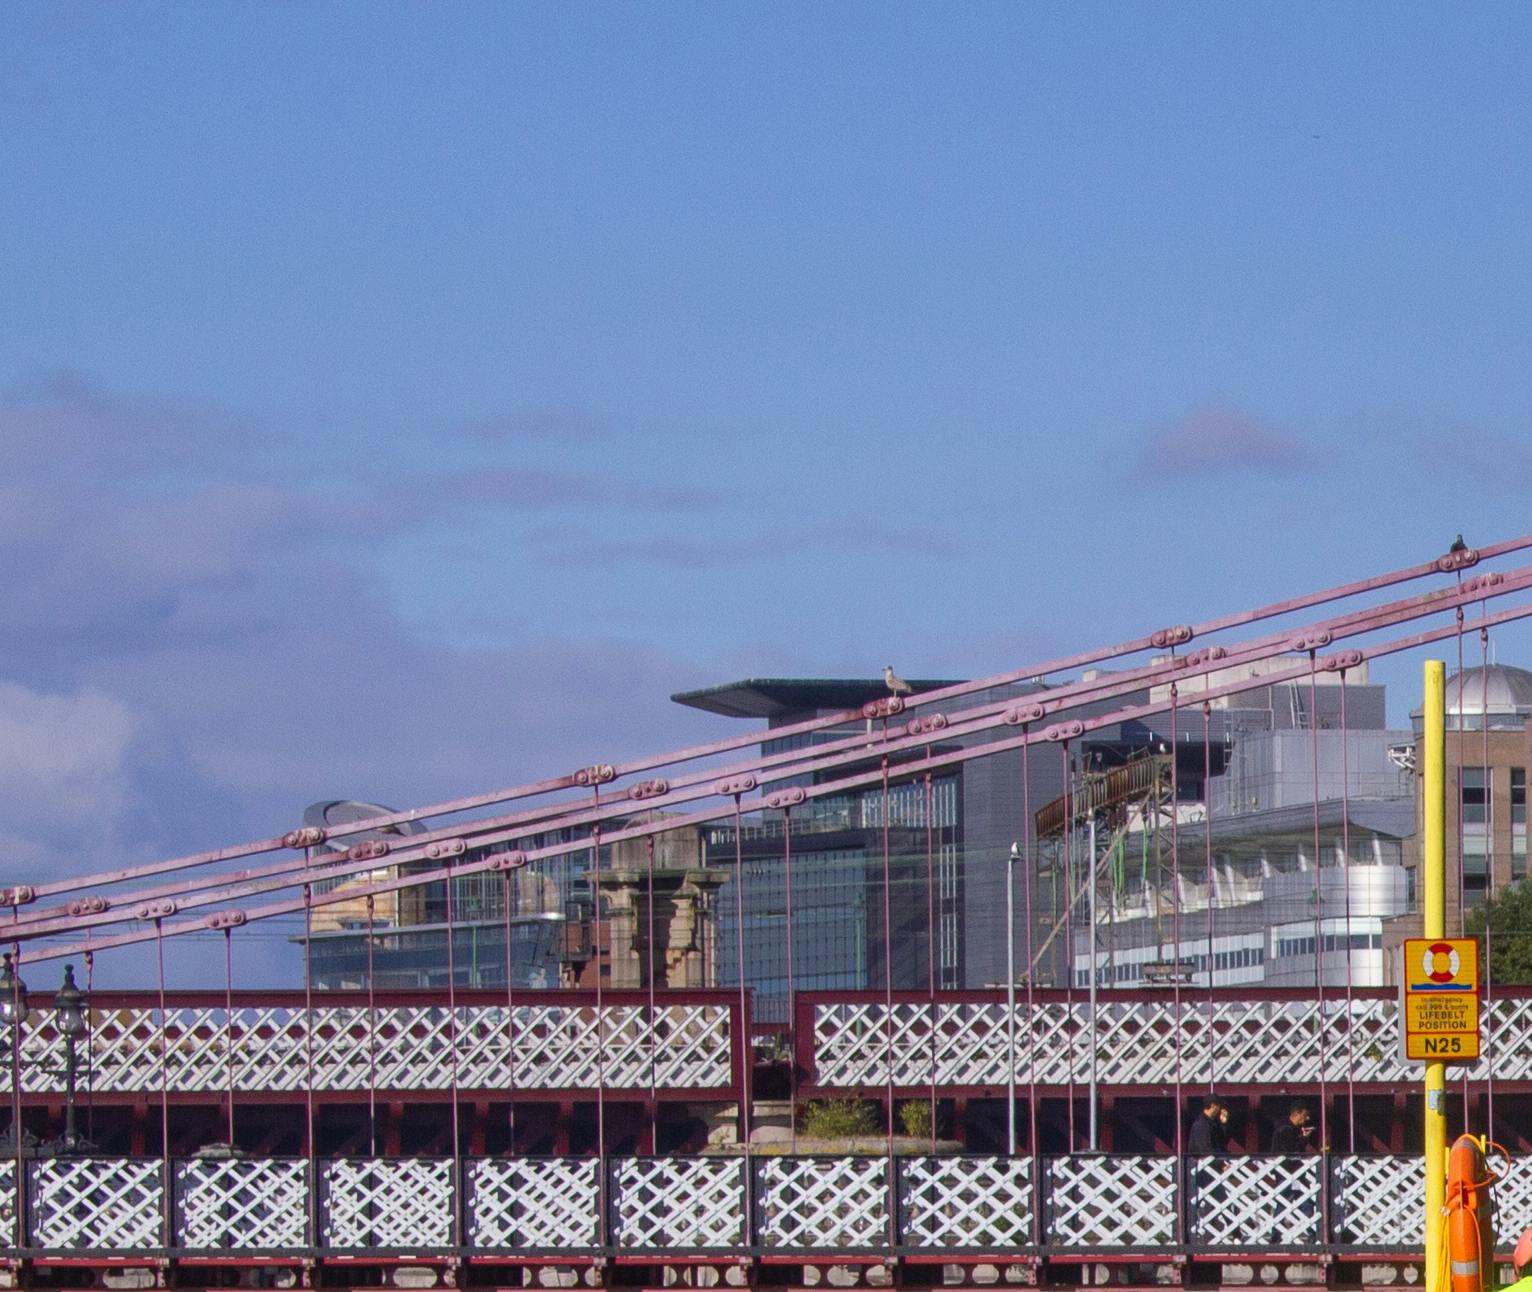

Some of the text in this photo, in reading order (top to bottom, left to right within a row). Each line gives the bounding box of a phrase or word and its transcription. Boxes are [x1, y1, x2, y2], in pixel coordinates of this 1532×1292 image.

[1419, 1011, 1465, 1020] LIFEBELT
[1418, 1021, 1467, 1030] POSITION
[1424, 1037, 1462, 1053] N25
